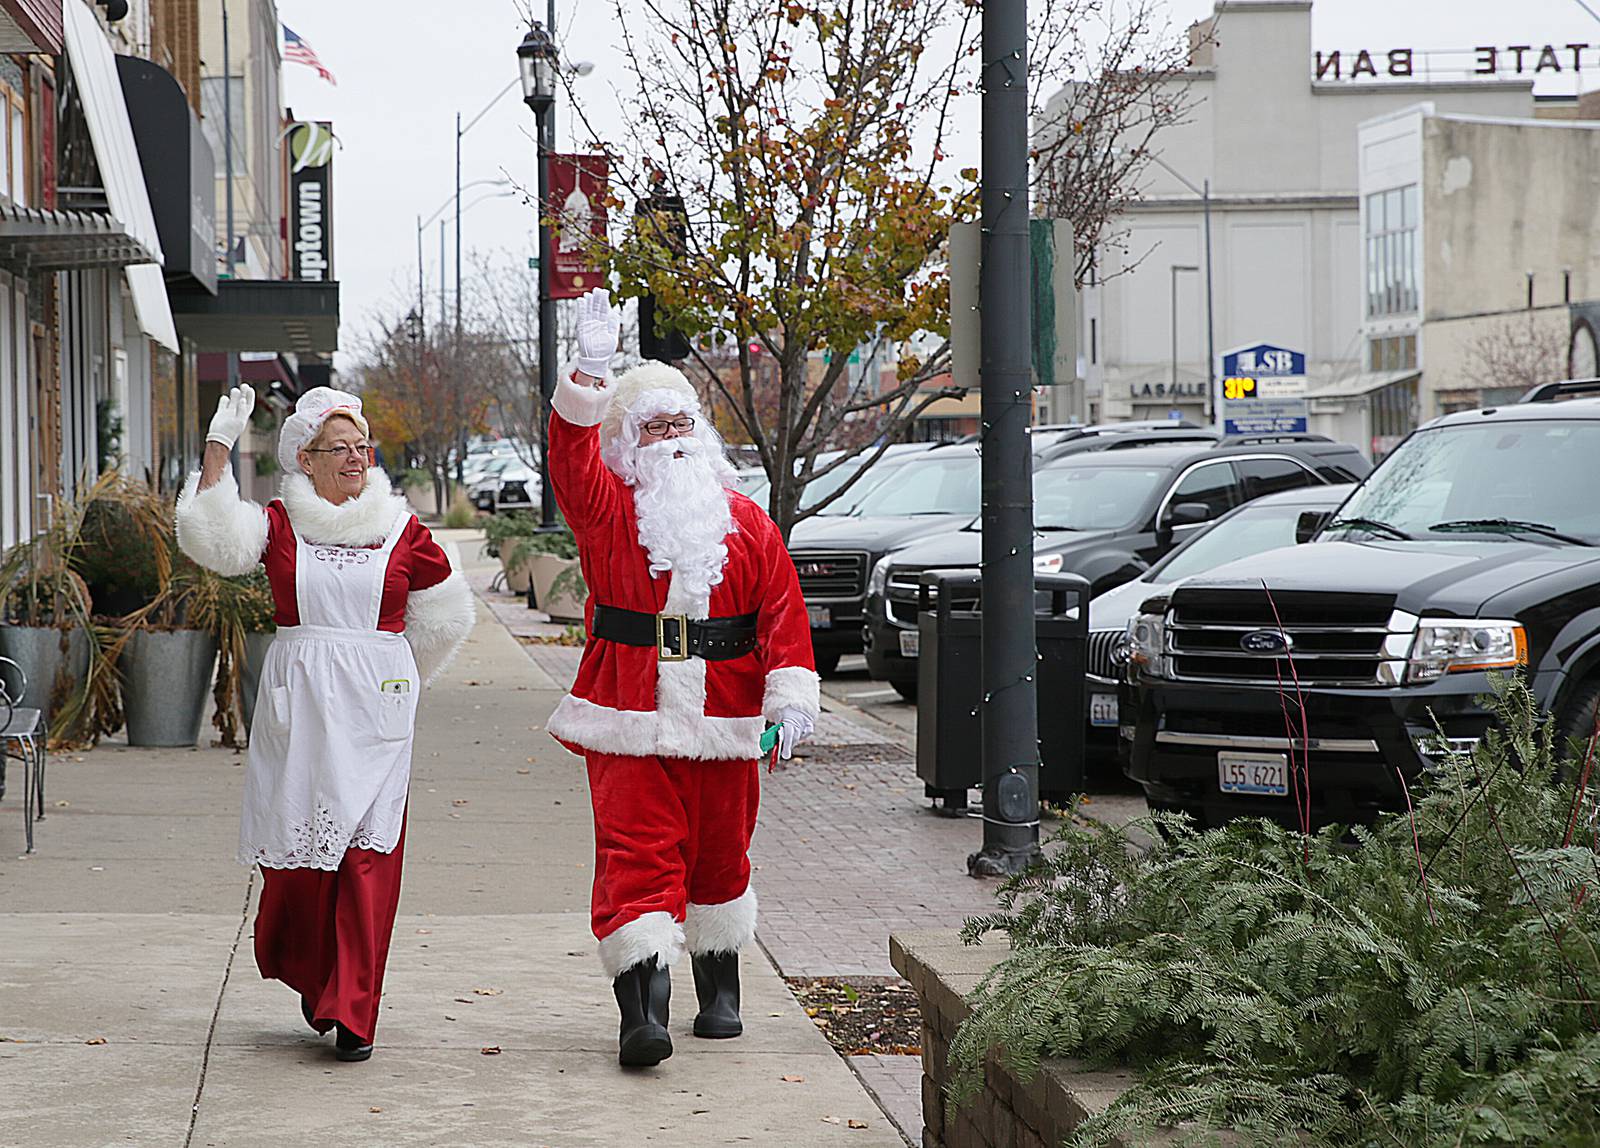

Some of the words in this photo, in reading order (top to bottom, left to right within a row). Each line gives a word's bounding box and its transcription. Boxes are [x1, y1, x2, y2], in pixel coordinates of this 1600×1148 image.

[295, 182, 327, 281] uptown
[1130, 383, 1206, 398] LASALLE
[1223, 764, 1246, 785] L55
[1254, 766, 1285, 787] 6221
